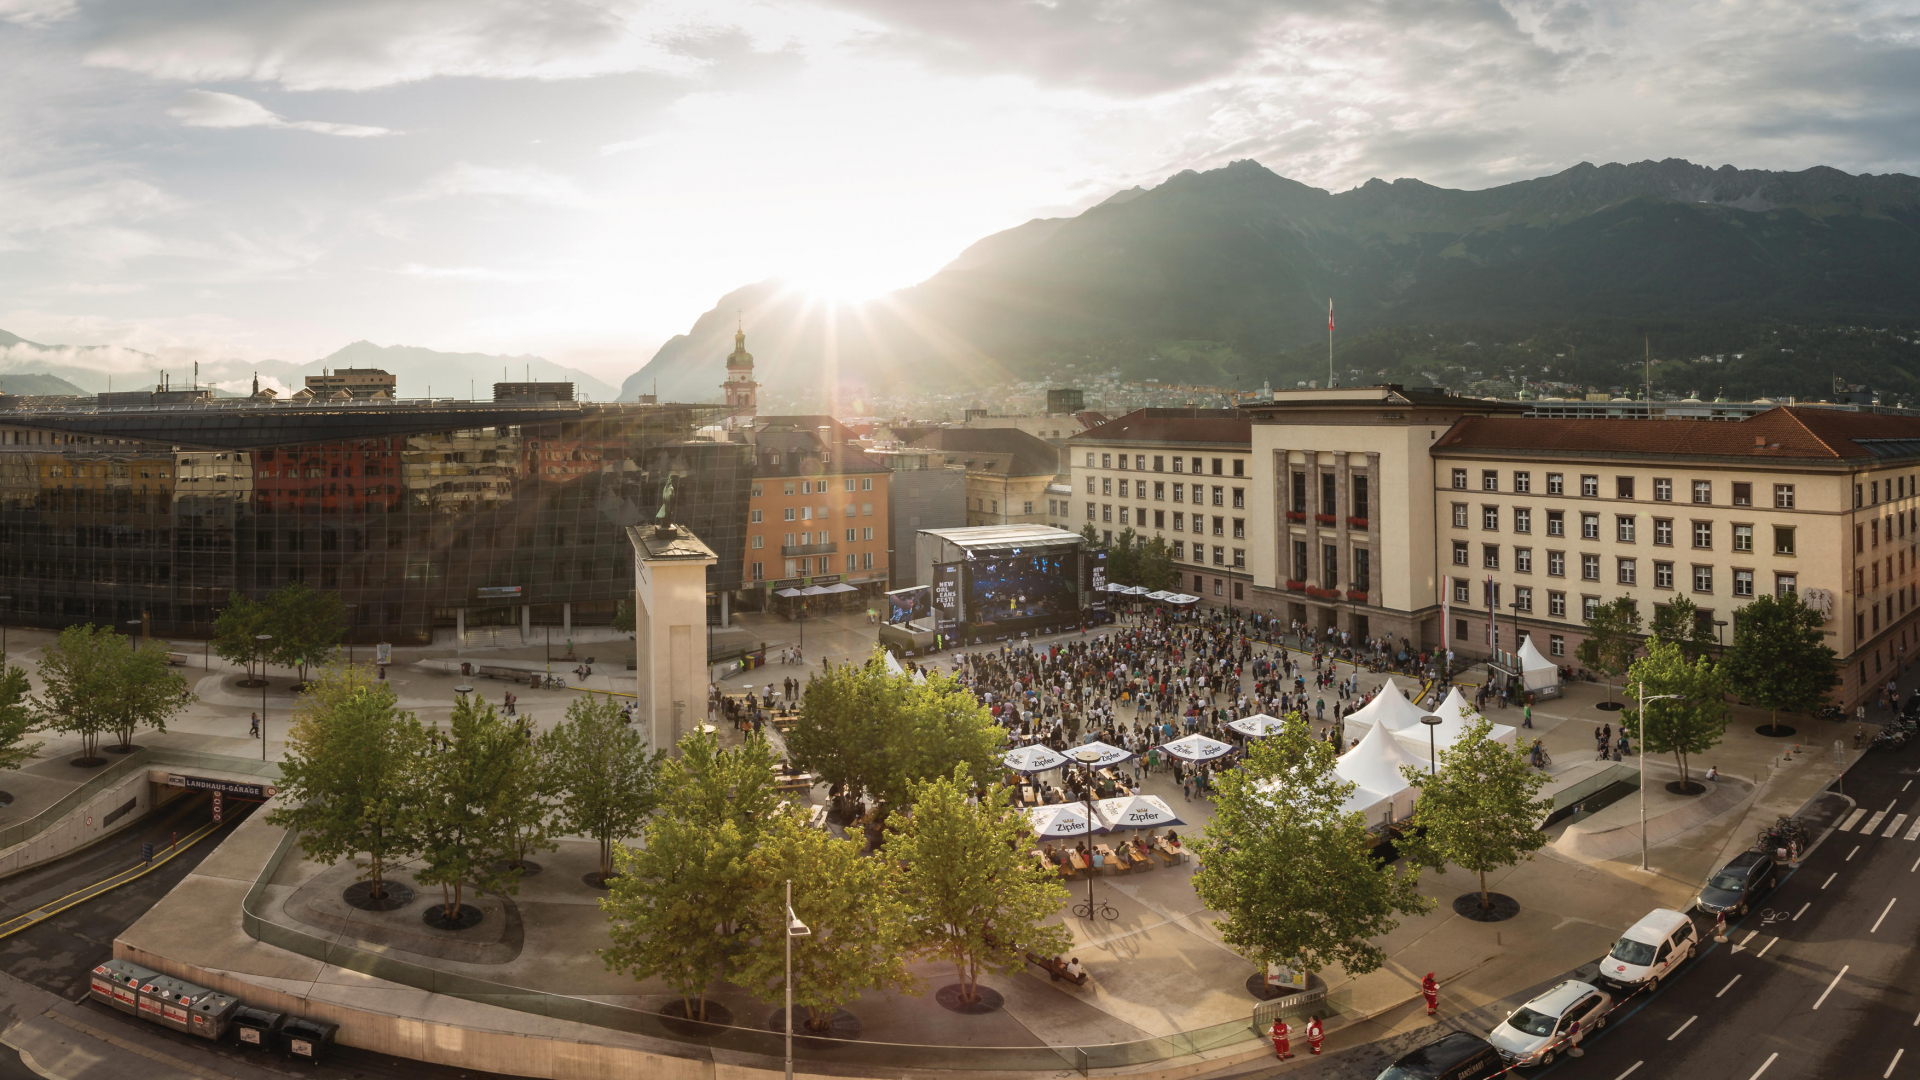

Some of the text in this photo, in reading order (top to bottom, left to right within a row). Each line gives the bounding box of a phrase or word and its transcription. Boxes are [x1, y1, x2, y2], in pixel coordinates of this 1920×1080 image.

[1173, 744, 1194, 756] Zipfer
[1202, 745, 1223, 756] Zipfer
[1031, 757, 1056, 768] Zipfer
[1100, 752, 1121, 762] Zipfer
[186, 780, 259, 795] LANDHAUS-GARAGE
[1128, 812, 1159, 822] Zipfer
[1055, 821, 1086, 833] Zipfer
